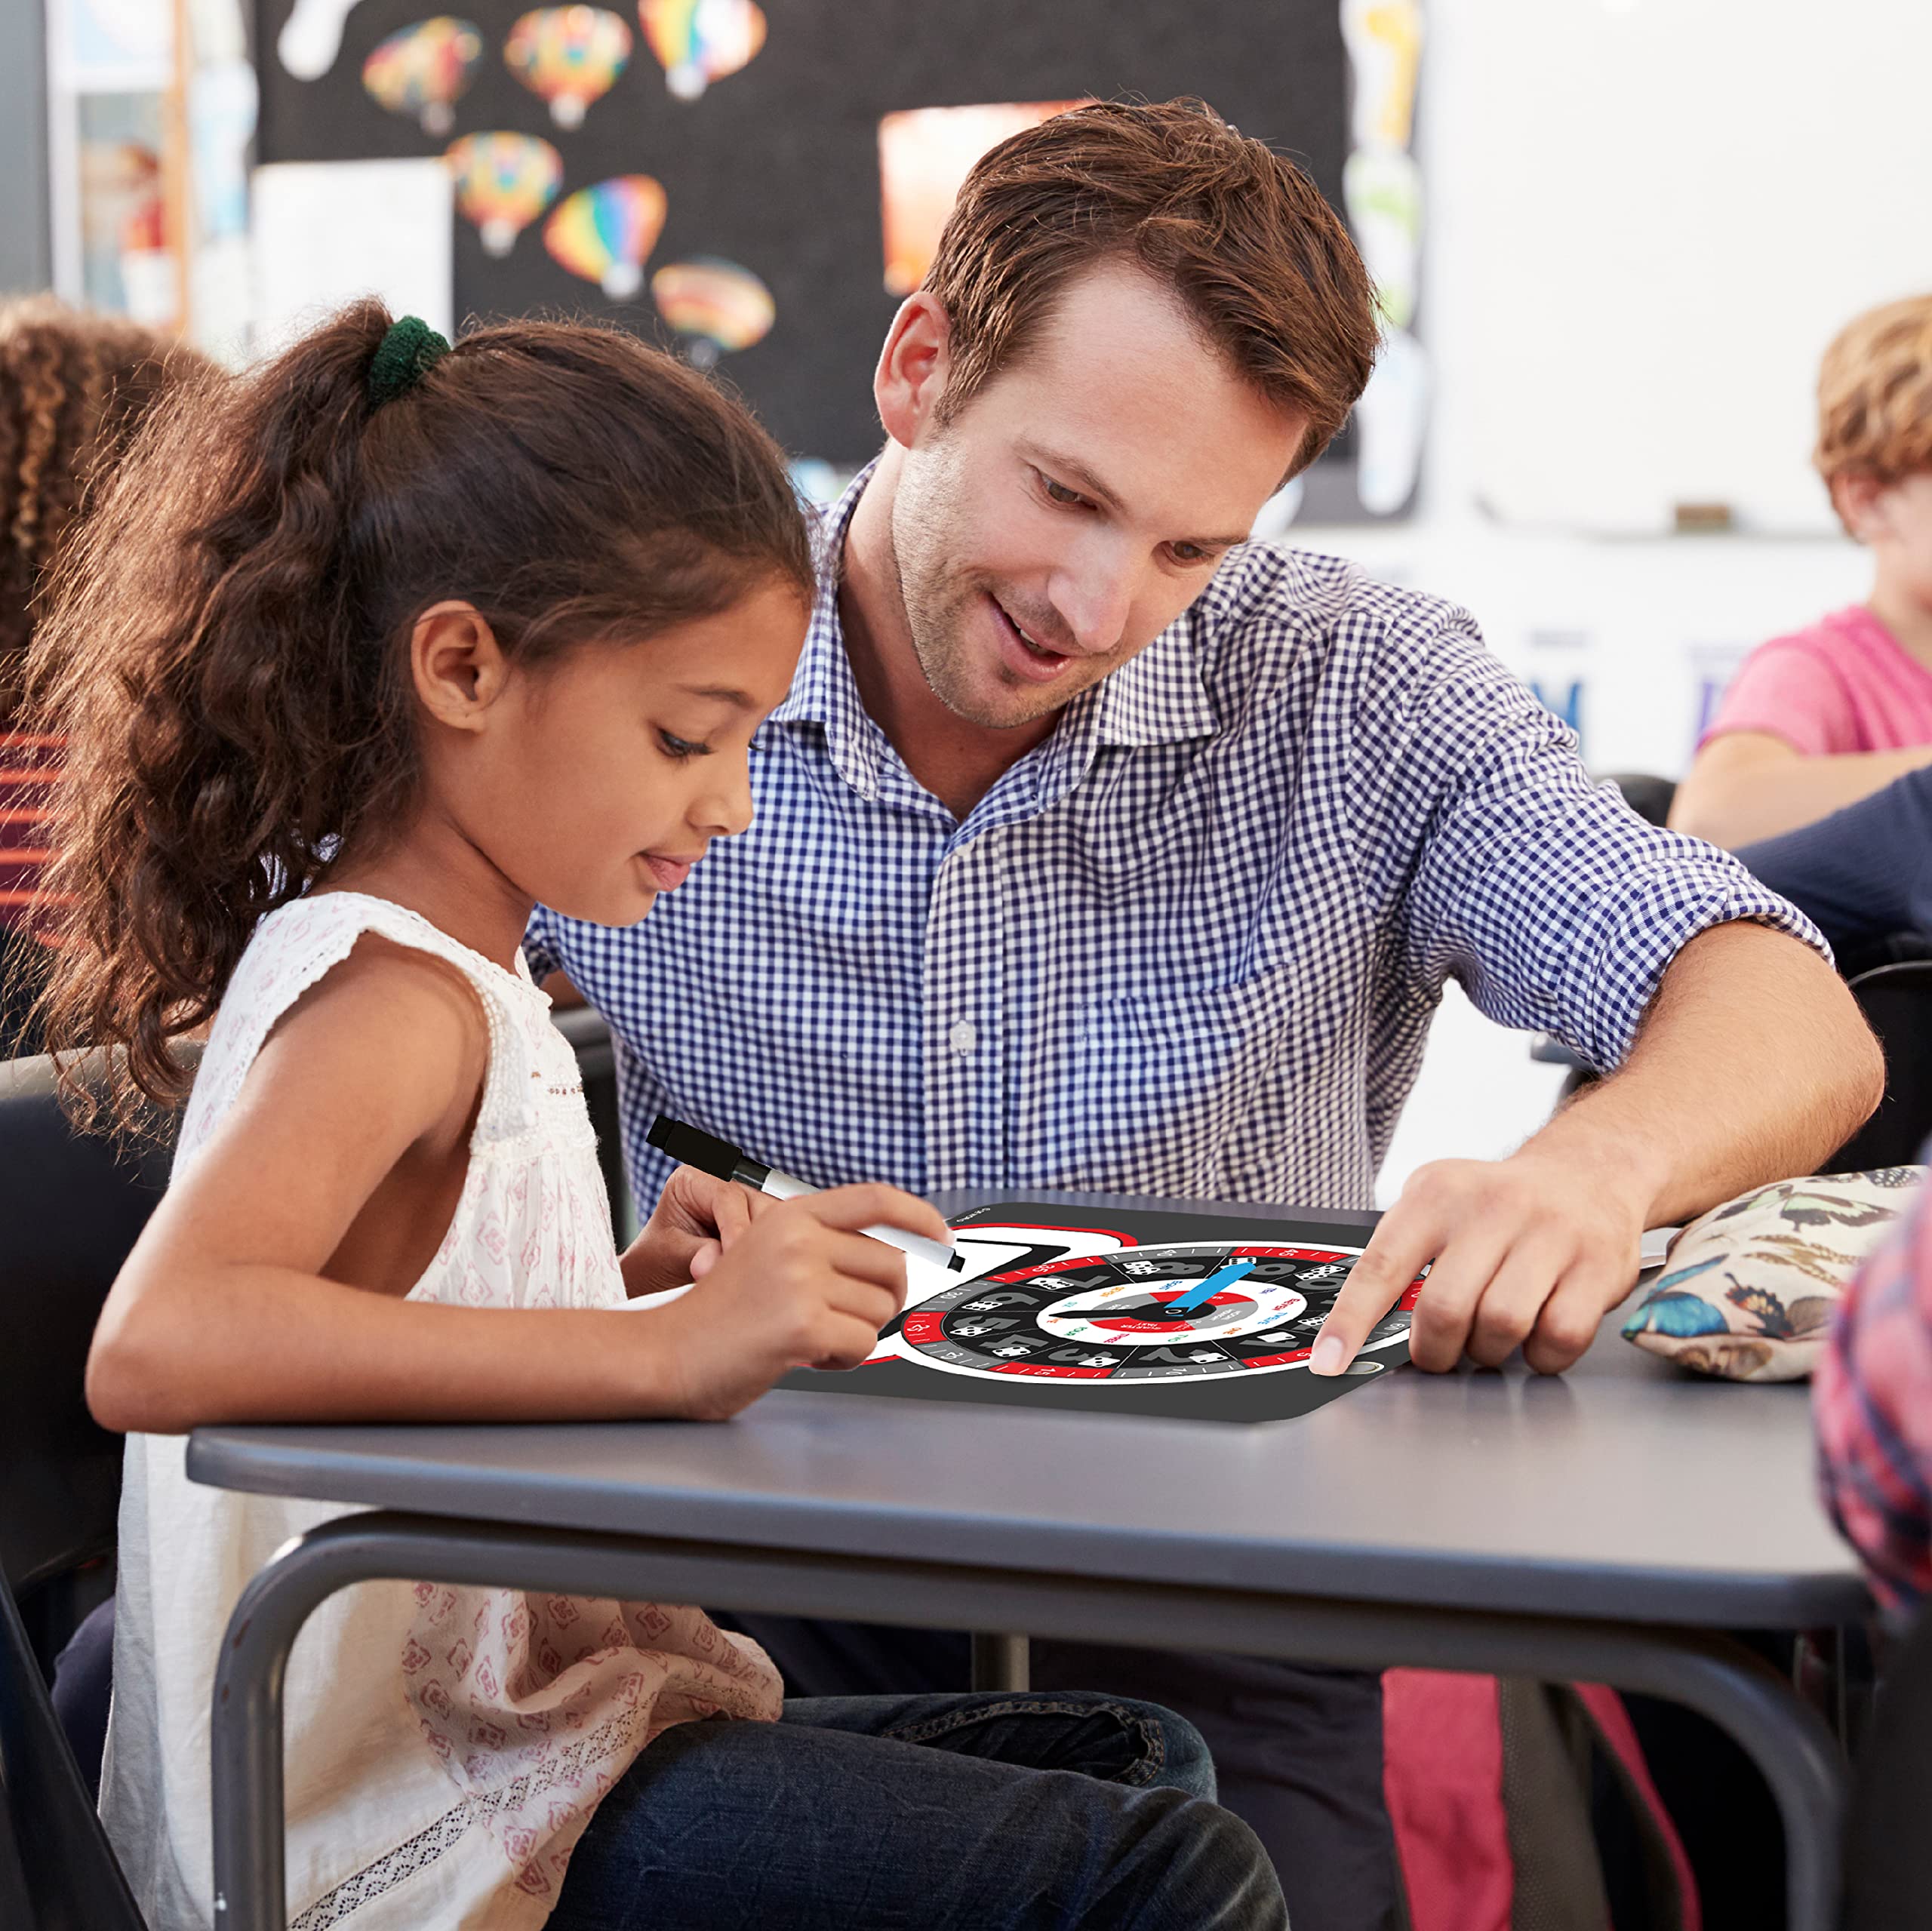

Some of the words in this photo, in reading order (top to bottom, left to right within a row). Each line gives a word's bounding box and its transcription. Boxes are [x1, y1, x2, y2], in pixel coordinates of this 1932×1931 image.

[1032, 1264, 1055, 1273] 35
[940, 1291, 963, 1299] 30
[981, 1292, 1040, 1305] 6
[952, 1315, 1020, 1330] 5
[1383, 1323, 1405, 1331] 60
[907, 1324, 930, 1332] 25
[979, 1333, 1051, 1350] 4
[940, 1351, 964, 1360] 20
